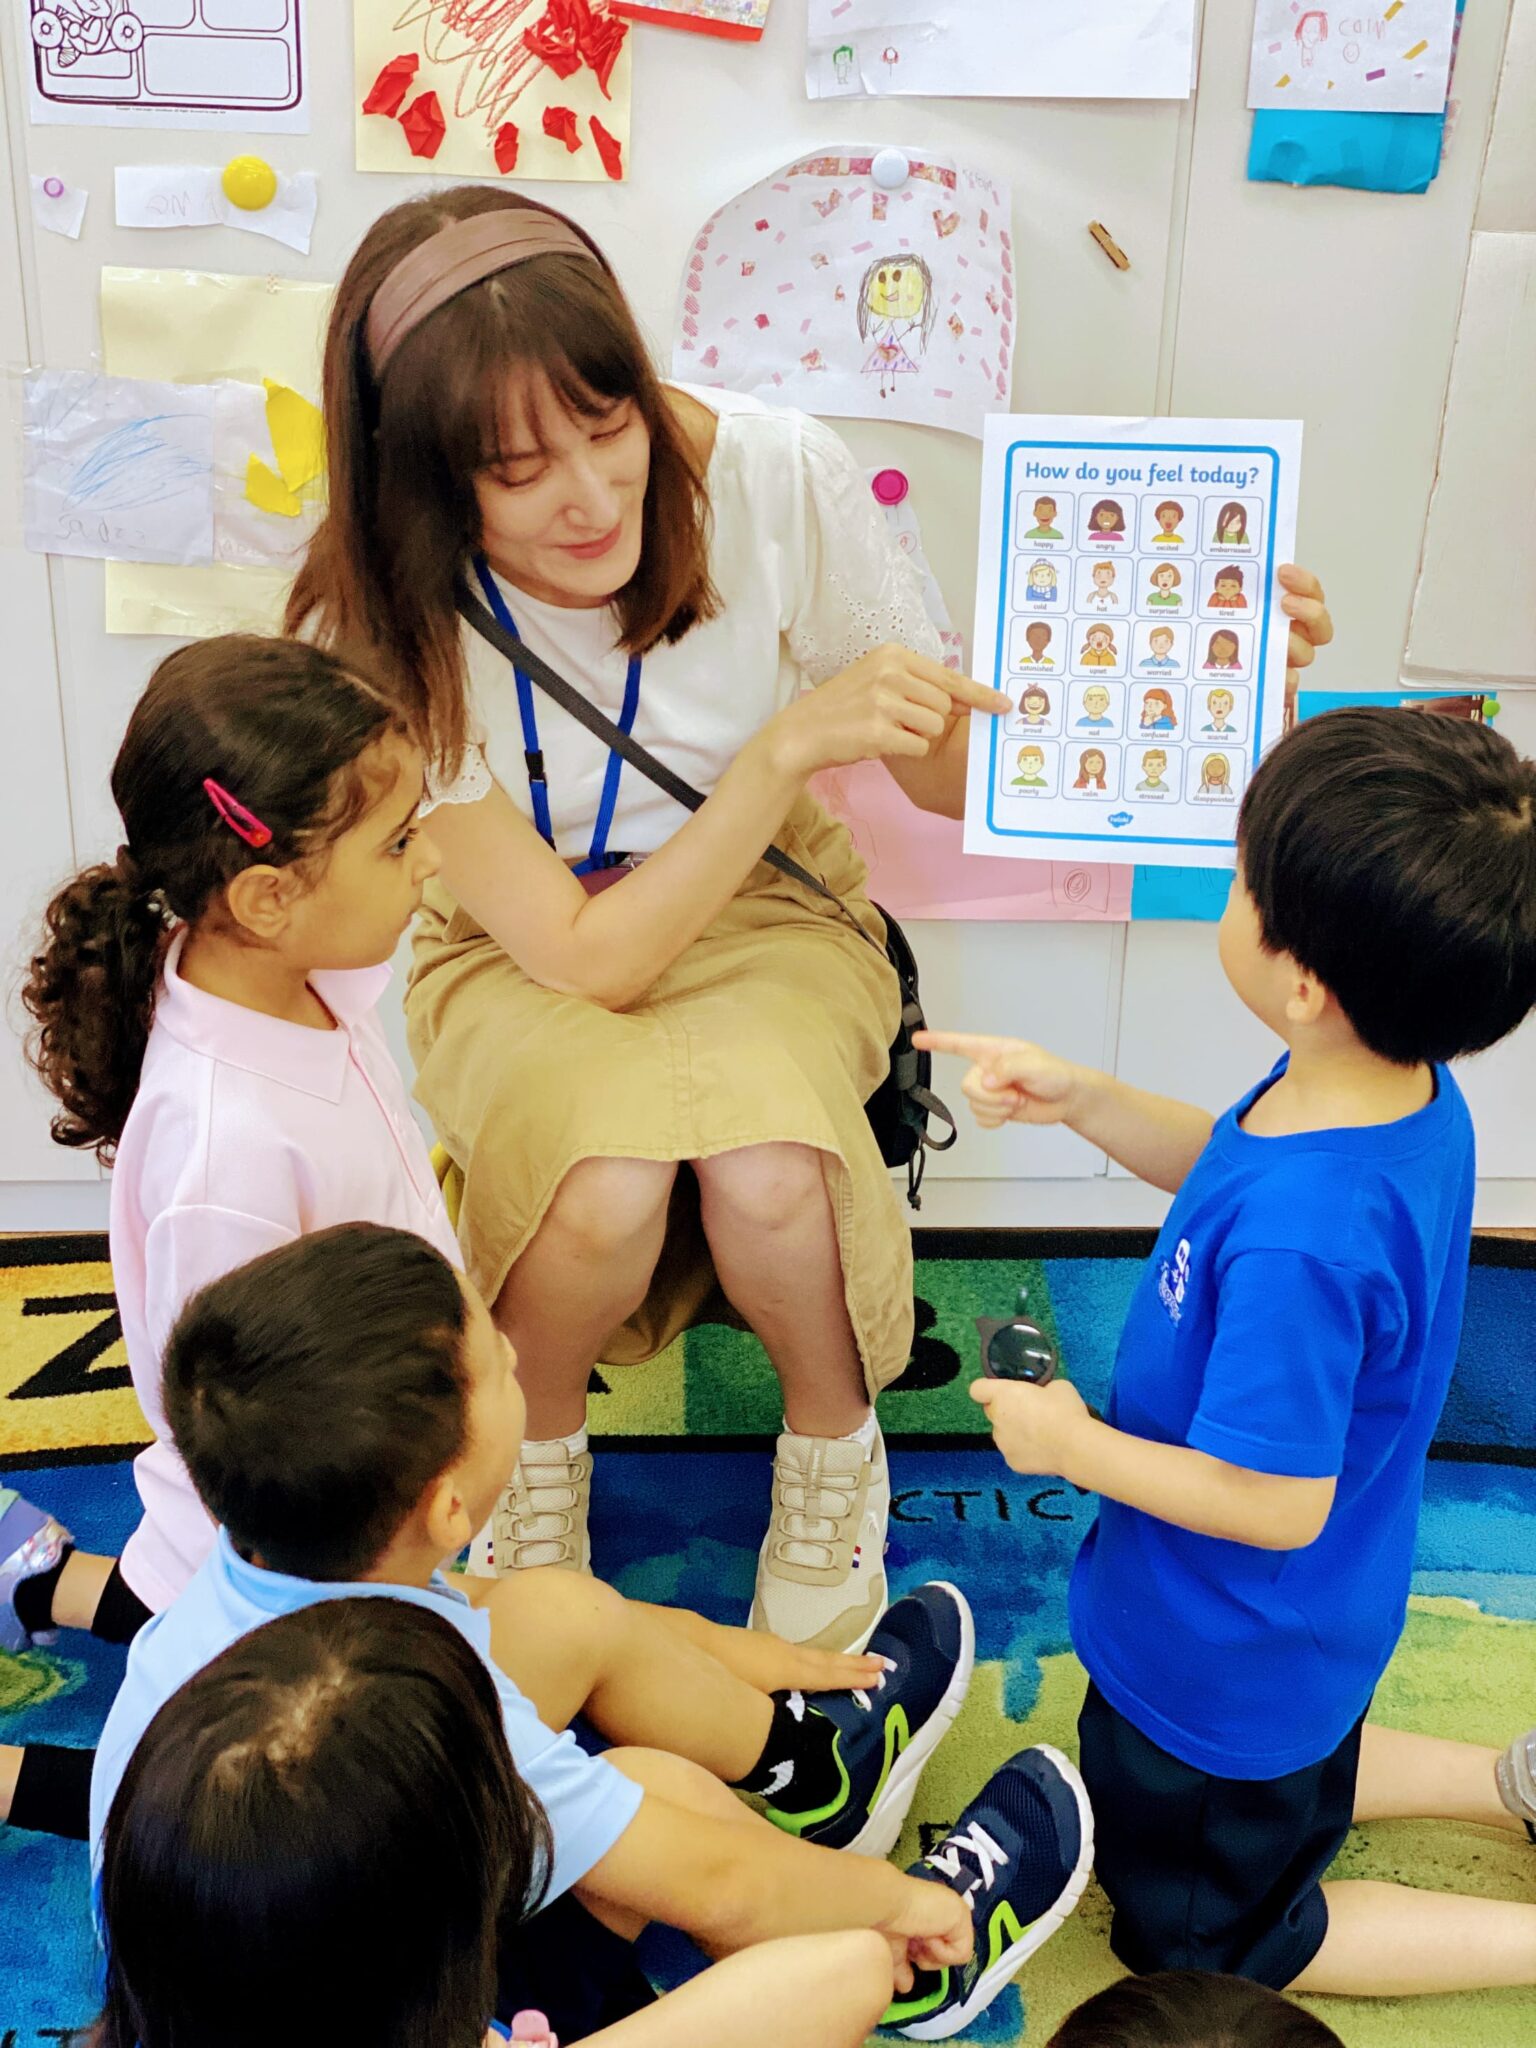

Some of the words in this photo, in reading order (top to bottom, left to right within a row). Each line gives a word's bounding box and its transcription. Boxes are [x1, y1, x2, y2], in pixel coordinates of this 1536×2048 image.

[1025, 461, 1069, 480] How
[1075, 462, 1099, 480] do
[1106, 467, 1142, 485] you
[1147, 463, 1183, 487] feel
[1190, 465, 1260, 488] today?
[1033, 540, 1054, 550] happy
[1095, 543, 1116, 551] angry
[1156, 544, 1179, 552] excited
[1033, 602, 1048, 610] cold
[1096, 604, 1108, 612] hot
[1149, 607, 1180, 616] surprised
[1218, 609, 1235, 617] tired
[1019, 664, 1054, 673] astonished
[1089, 667, 1107, 675] upset
[1147, 669, 1172, 677] worried
[1023, 726, 1043, 734] proud
[1141, 730, 1170, 739] confused
[1018, 787, 1040, 796] poorly
[889, 1488, 1073, 1523] CTIC
